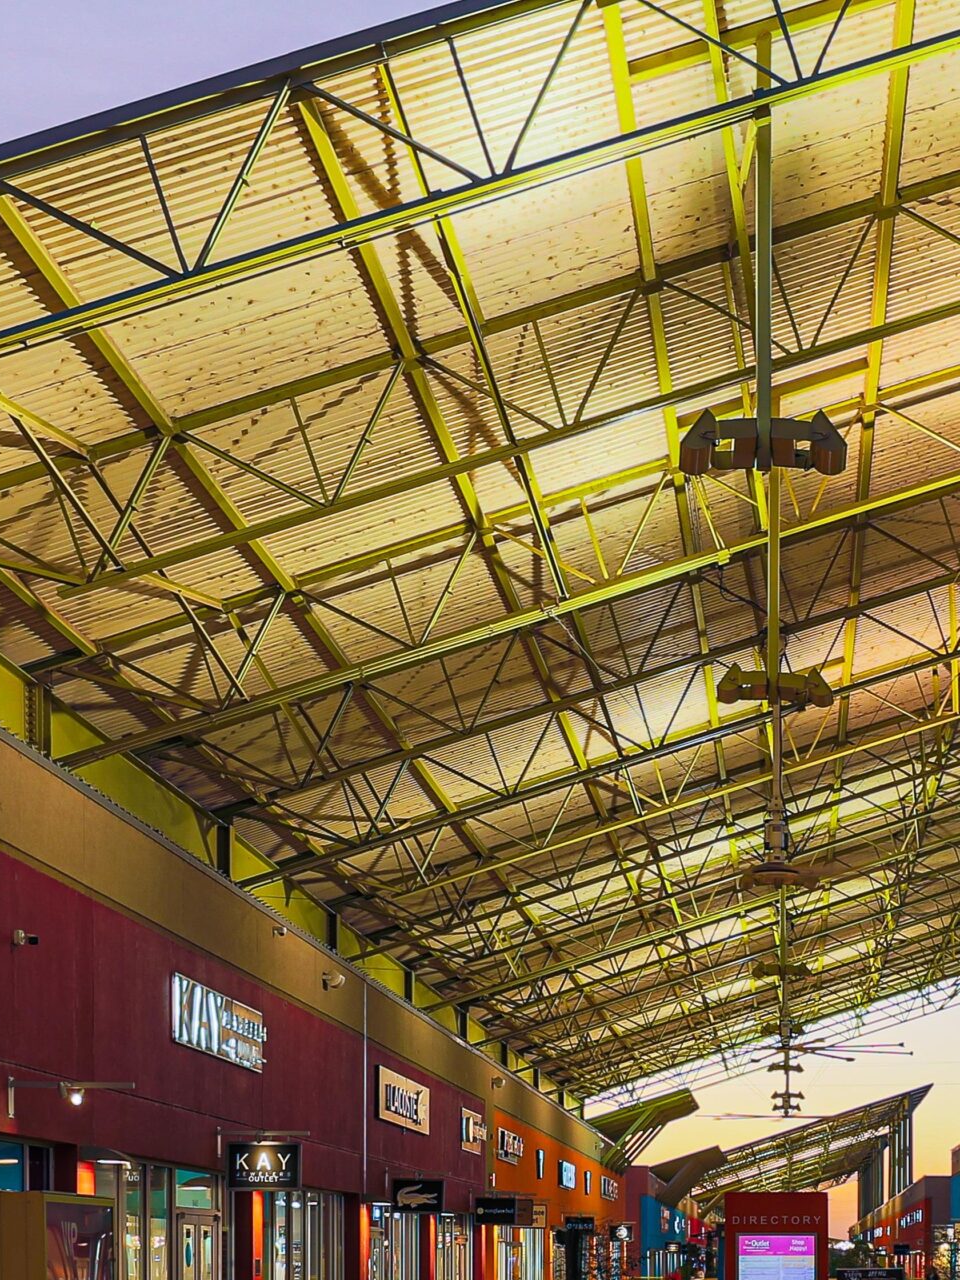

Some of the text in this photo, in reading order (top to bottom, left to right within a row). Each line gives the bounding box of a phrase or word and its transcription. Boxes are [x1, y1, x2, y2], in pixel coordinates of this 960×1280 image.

[236, 1152, 291, 1171] KAY
[248, 1175, 279, 1183] OUTLET
[732, 1215, 821, 1225] DIRECTORY
